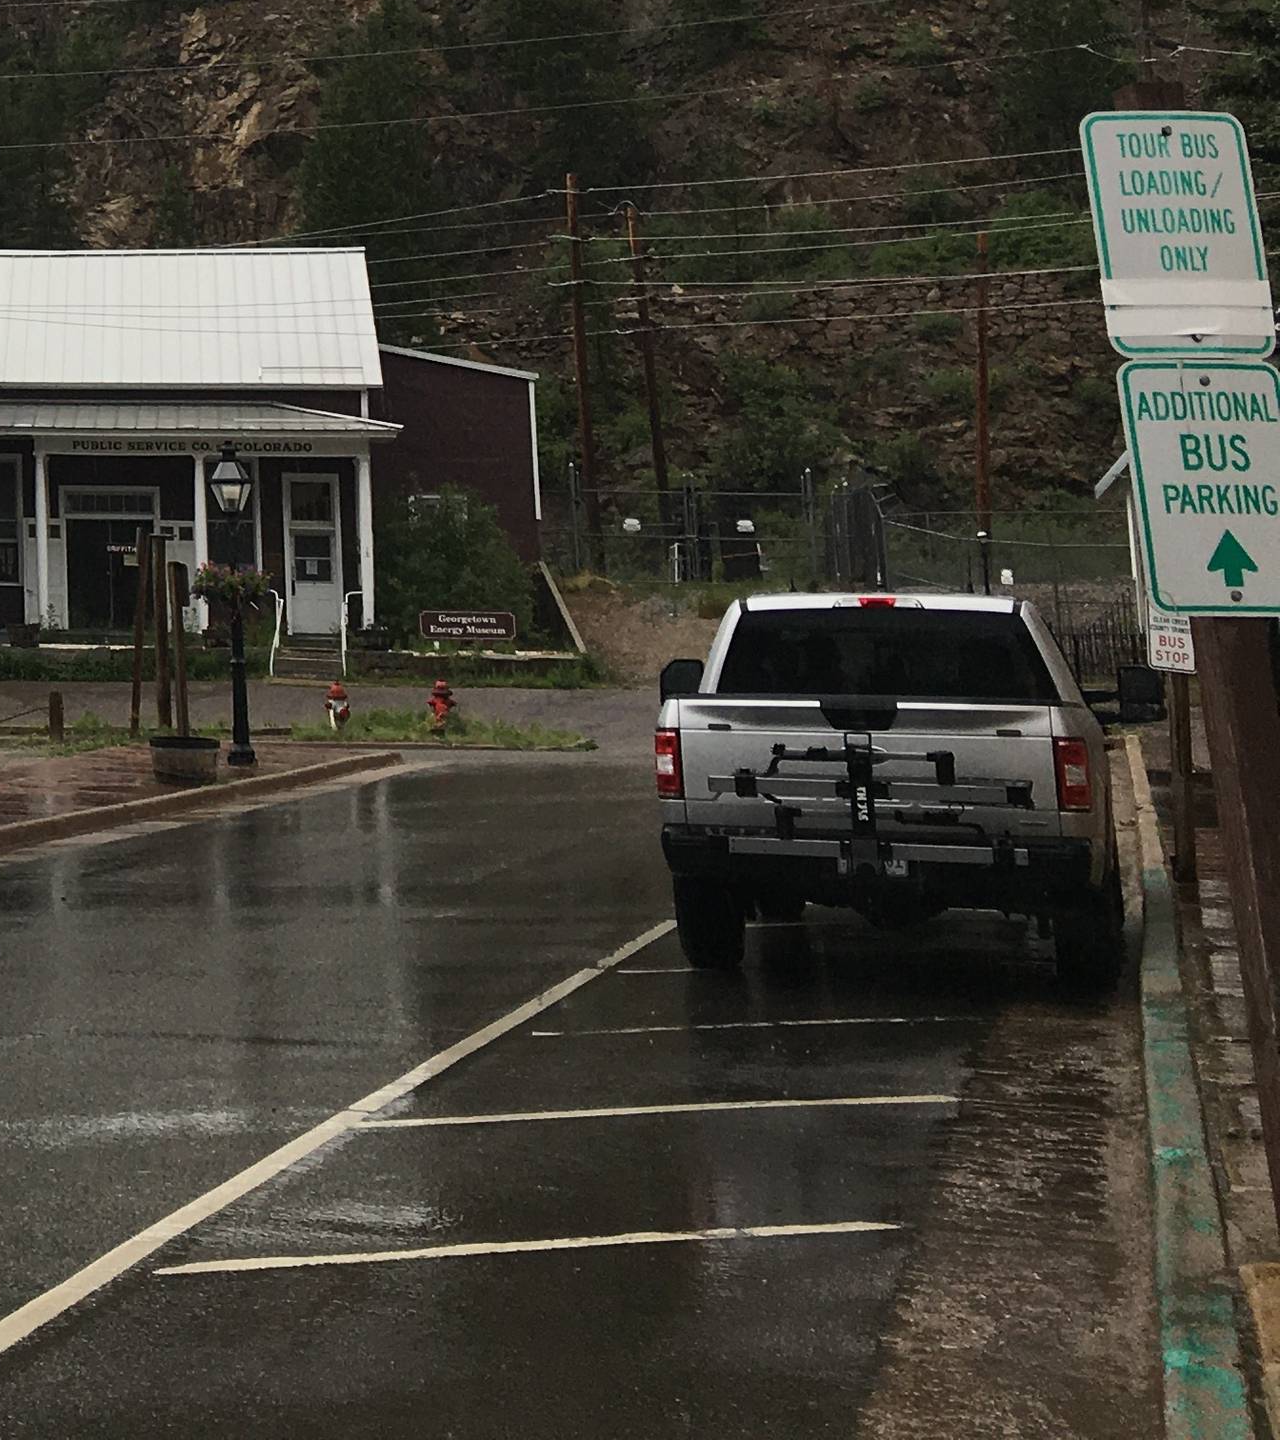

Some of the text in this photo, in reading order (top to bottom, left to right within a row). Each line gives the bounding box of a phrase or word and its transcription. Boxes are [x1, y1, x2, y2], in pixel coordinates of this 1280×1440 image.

[1116, 132, 1219, 159] TOUR BUS
[1121, 208, 1236, 234] UNLOADING
[1160, 245, 1208, 272] ONLY
[1137, 391, 1278, 422] ADDITIONAL
[72, 440, 122, 451] PUBLIC
[127, 440, 186, 451] SERVICE
[1180, 433, 1251, 472] BUS
[1162, 484, 1278, 516] PARKING
[430, 624, 506, 635] Energy Museum
[438, 614, 497, 625] Georgetown
[1159, 635, 1185, 649] BUS
[1155, 650, 1190, 664] STOP
